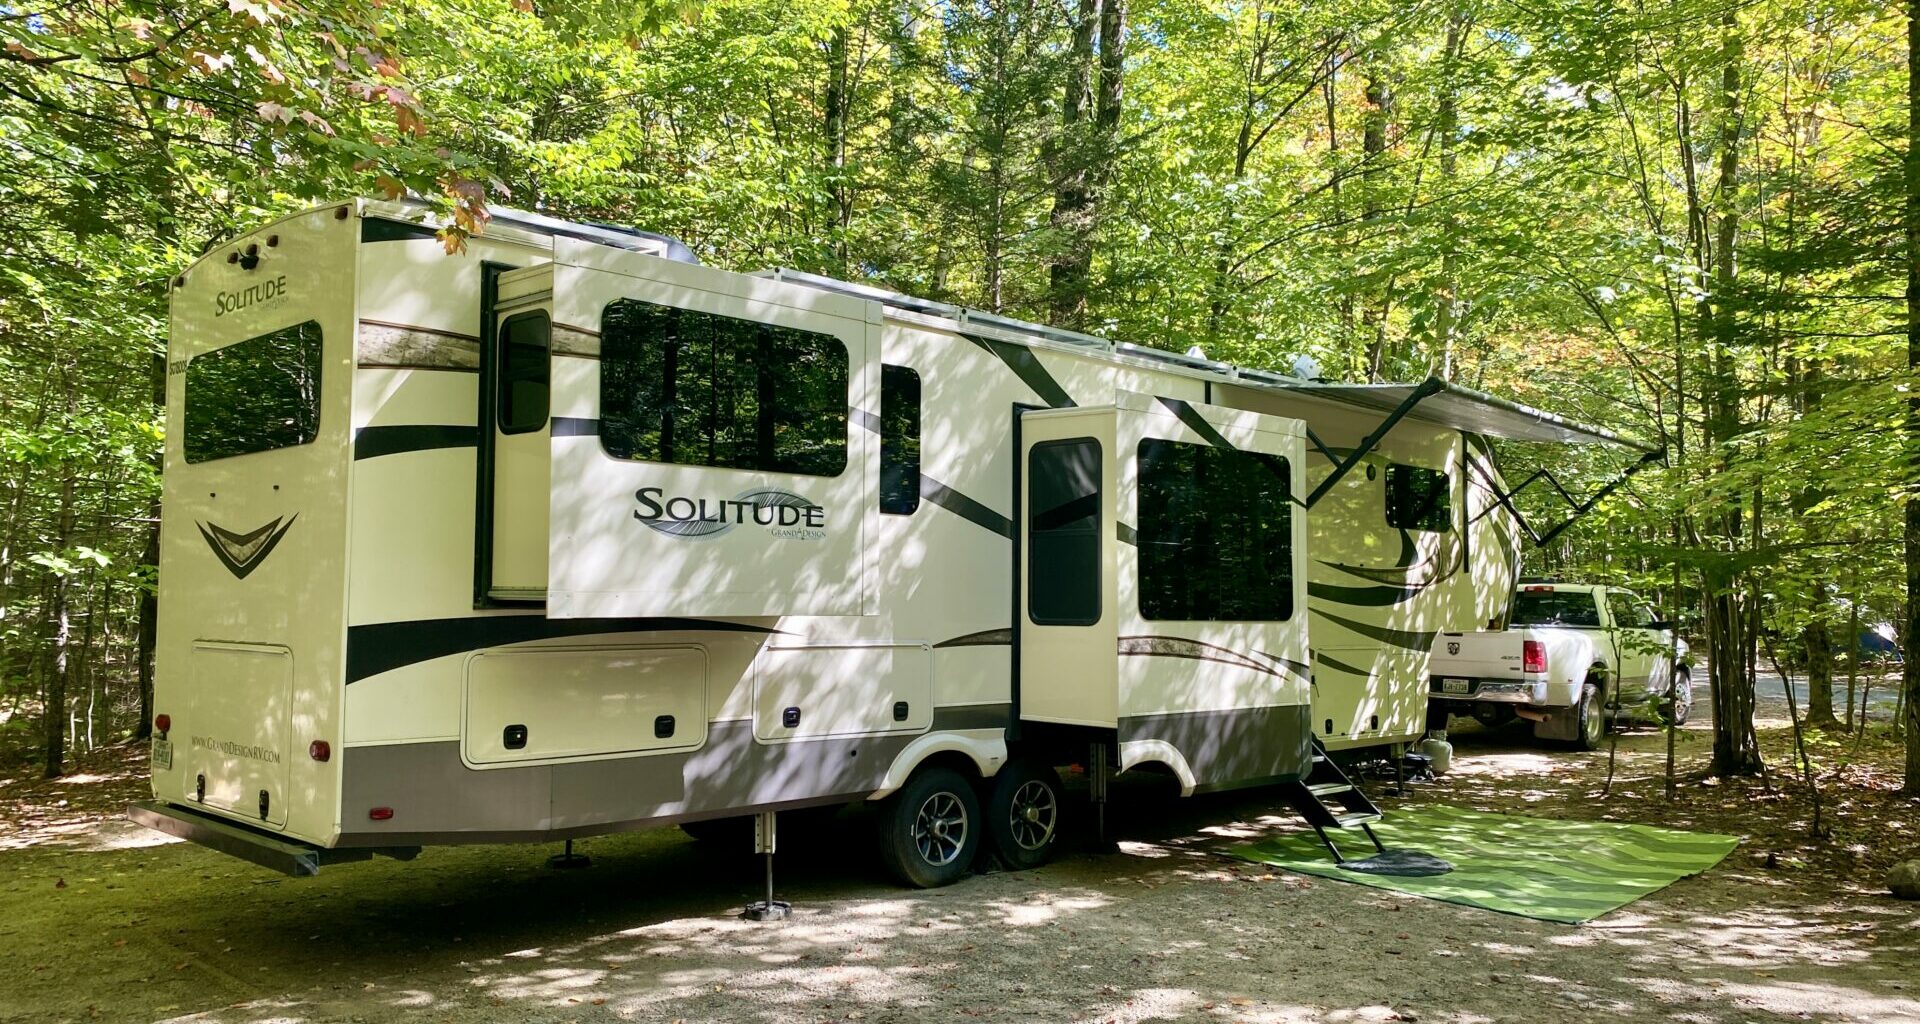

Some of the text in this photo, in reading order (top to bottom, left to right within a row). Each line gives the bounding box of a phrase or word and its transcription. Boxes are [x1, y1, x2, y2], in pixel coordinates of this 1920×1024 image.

[215, 275, 287, 317] SOLITUDE
[633, 487, 825, 528] SOLITUDE
[771, 528, 797, 537] GRAND
[802, 529, 827, 539] DESIGN
